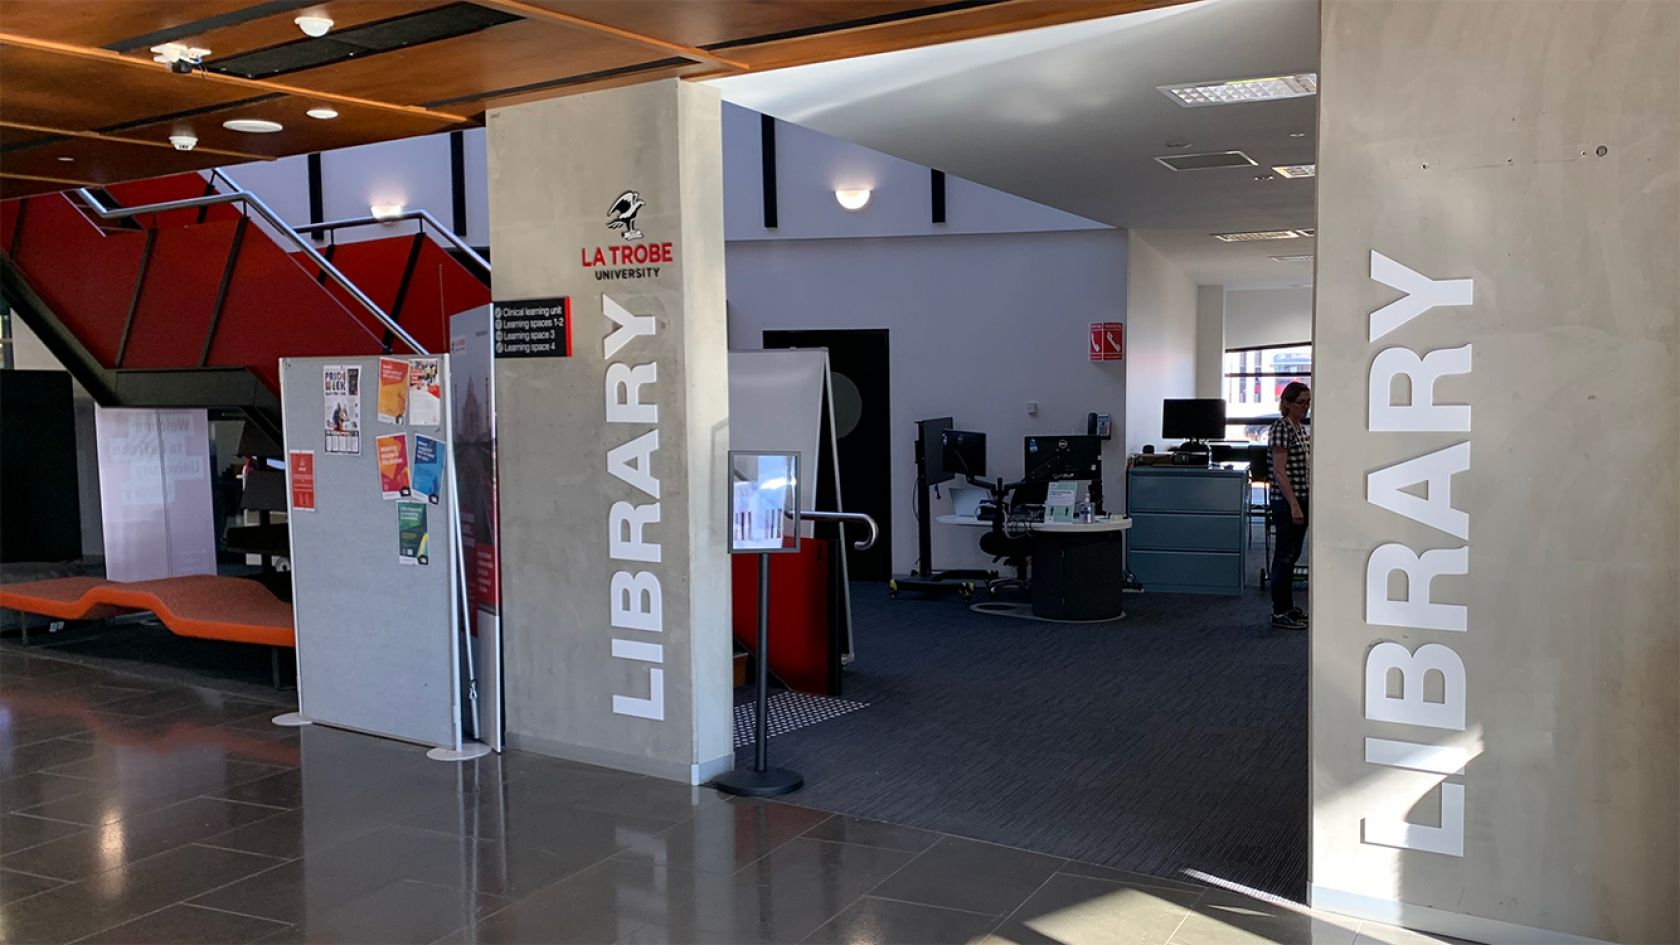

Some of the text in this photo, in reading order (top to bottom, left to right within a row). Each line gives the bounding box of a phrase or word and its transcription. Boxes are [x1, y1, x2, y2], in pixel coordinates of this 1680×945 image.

[581, 242, 673, 267] LA TROBE
[595, 267, 661, 280] UNIVERSITY
[503, 306, 562, 318] Clinical learning unit
[503, 317, 564, 330] Learning spaces 1-2
[503, 330, 556, 342] Learning space 3
[504, 342, 531, 354] Learning
[531, 342, 550, 353] space
[602, 293, 665, 721] LIBRARY
[1363, 249, 1474, 858] LIBRARY
